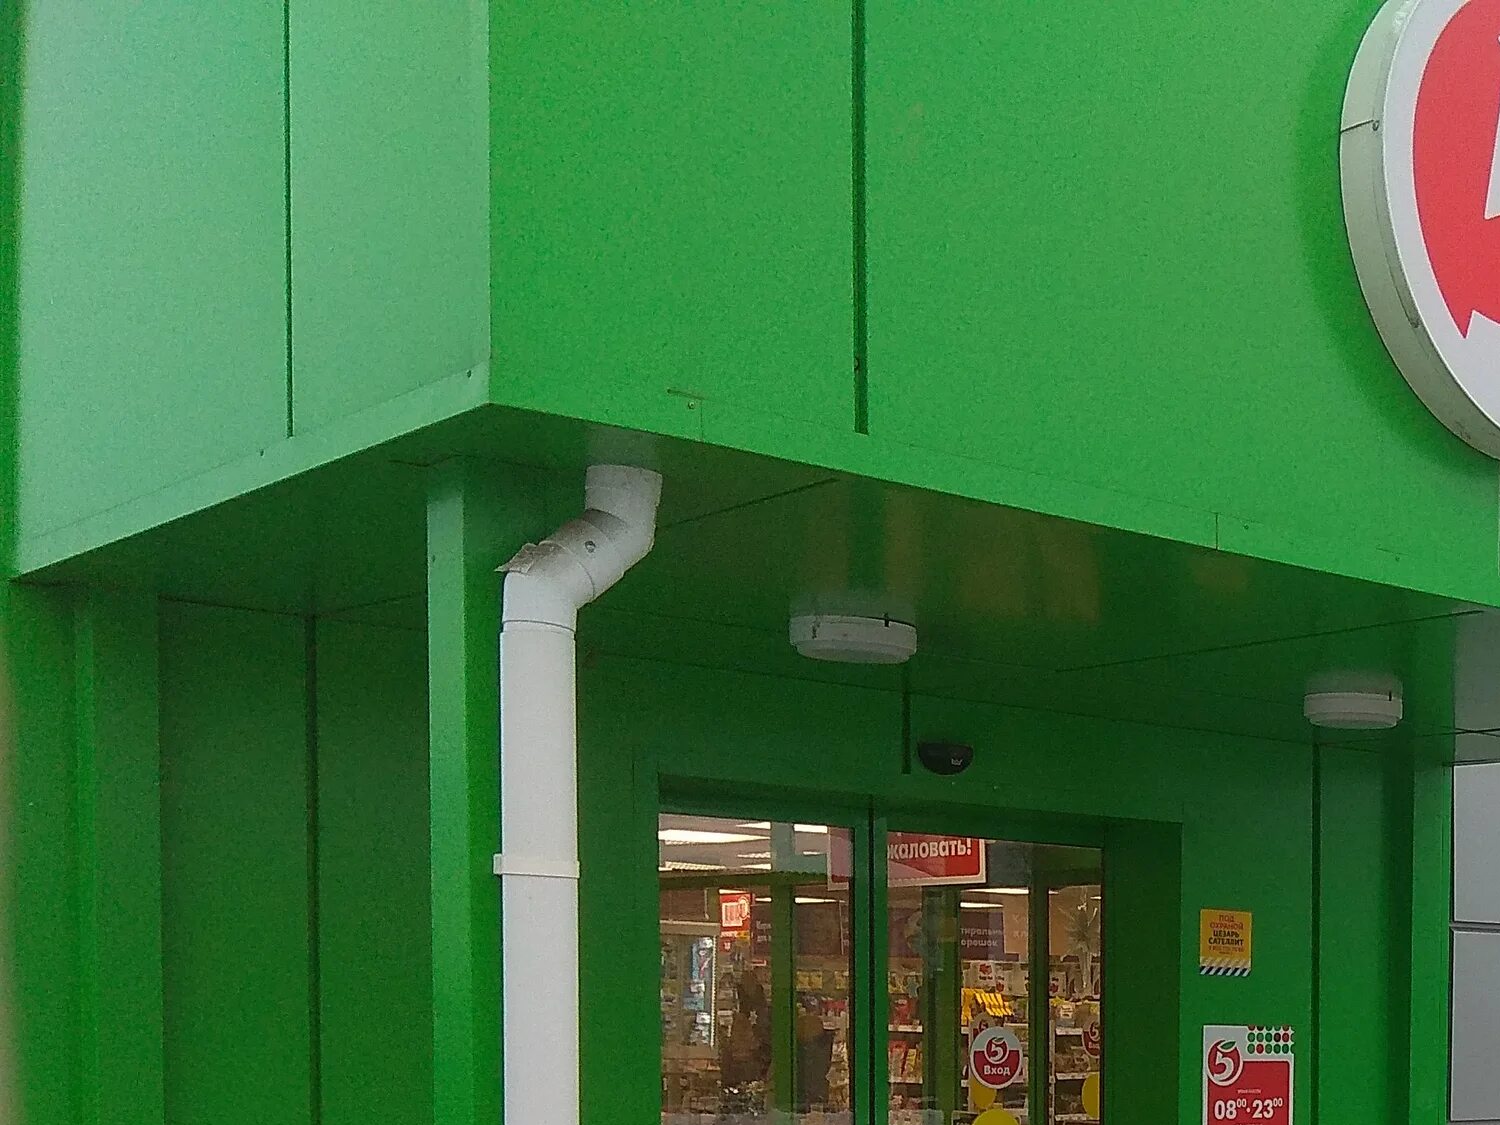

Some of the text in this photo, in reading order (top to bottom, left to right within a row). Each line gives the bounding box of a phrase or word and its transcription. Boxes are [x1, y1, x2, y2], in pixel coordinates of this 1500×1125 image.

[1218, 914, 1235, 922] ПОД
[1213, 929, 1240, 938] ЦЕЗАРЬ
[984, 1065, 1011, 1076] Вход
